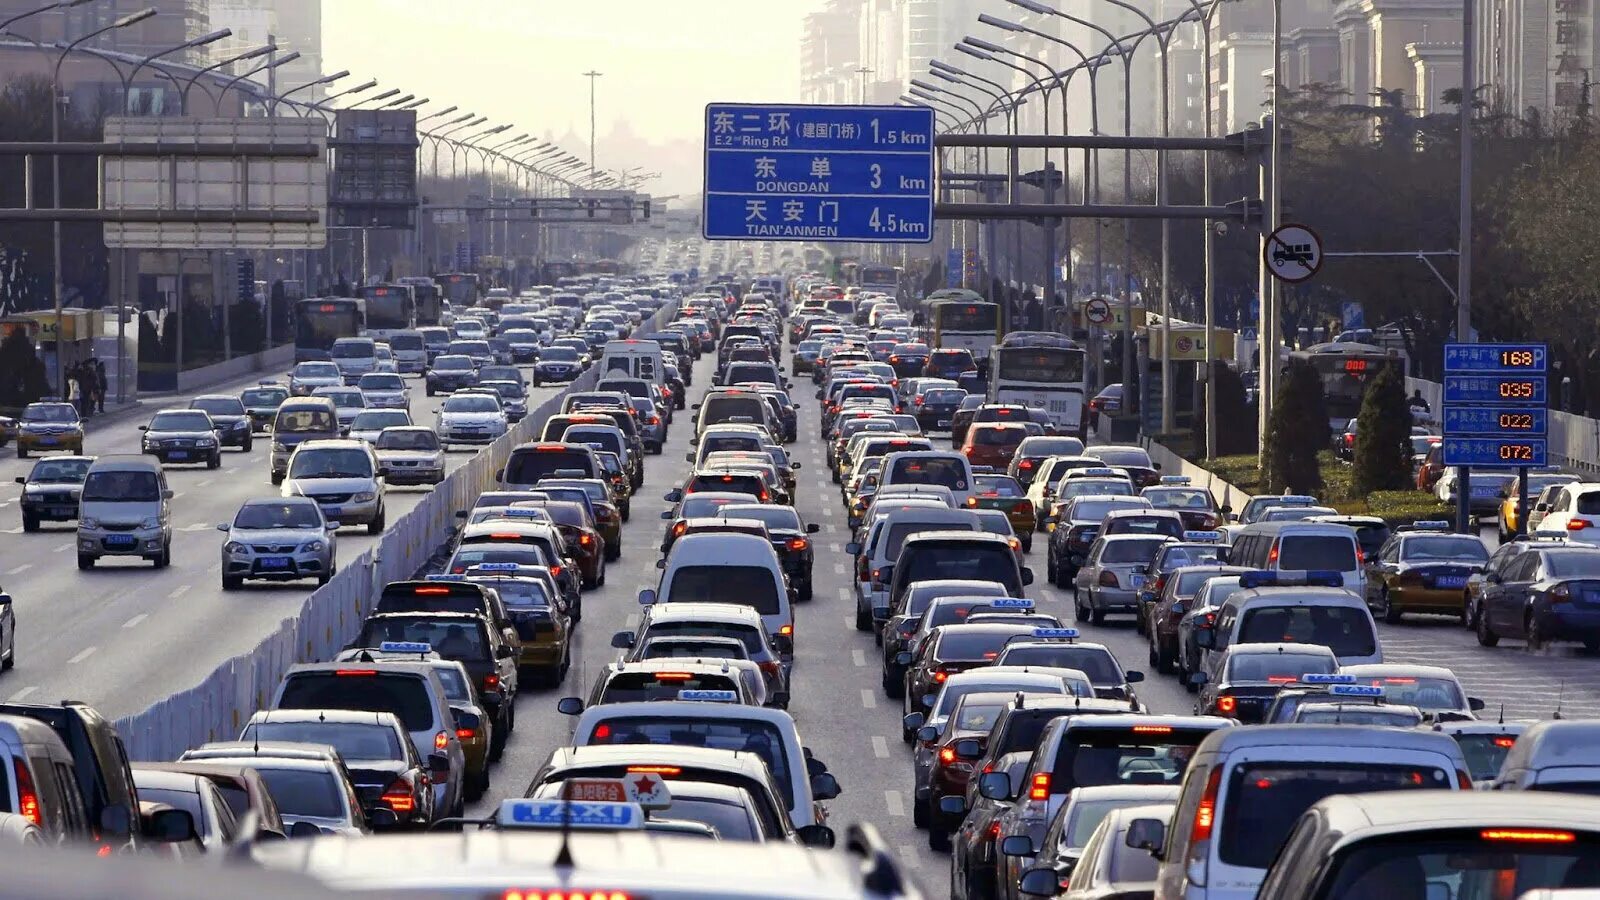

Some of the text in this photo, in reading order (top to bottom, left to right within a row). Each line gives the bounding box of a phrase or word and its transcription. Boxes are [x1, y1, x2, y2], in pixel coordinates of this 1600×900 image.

[713, 112, 790, 134] 东二环
[870, 118, 897, 144] 1.5
[901, 131, 926, 144] km
[742, 136, 769, 148] Ring
[773, 136, 789, 146] Rd
[755, 156, 926, 189] 东单 3 km
[756, 181, 829, 192] DONGDAN
[745, 199, 925, 233] 天安门 4.5 km
[746, 224, 838, 237] TIAN'ANMEN
[1459, 348, 1499, 360] 中海广场
[1503, 351, 1532, 365] 168
[1533, 348, 1544, 368] P
[1500, 383, 1532, 397] 035
[1500, 414, 1532, 428] 022
[1500, 445, 1532, 459] 072
[525, 805, 623, 816] TAXI
